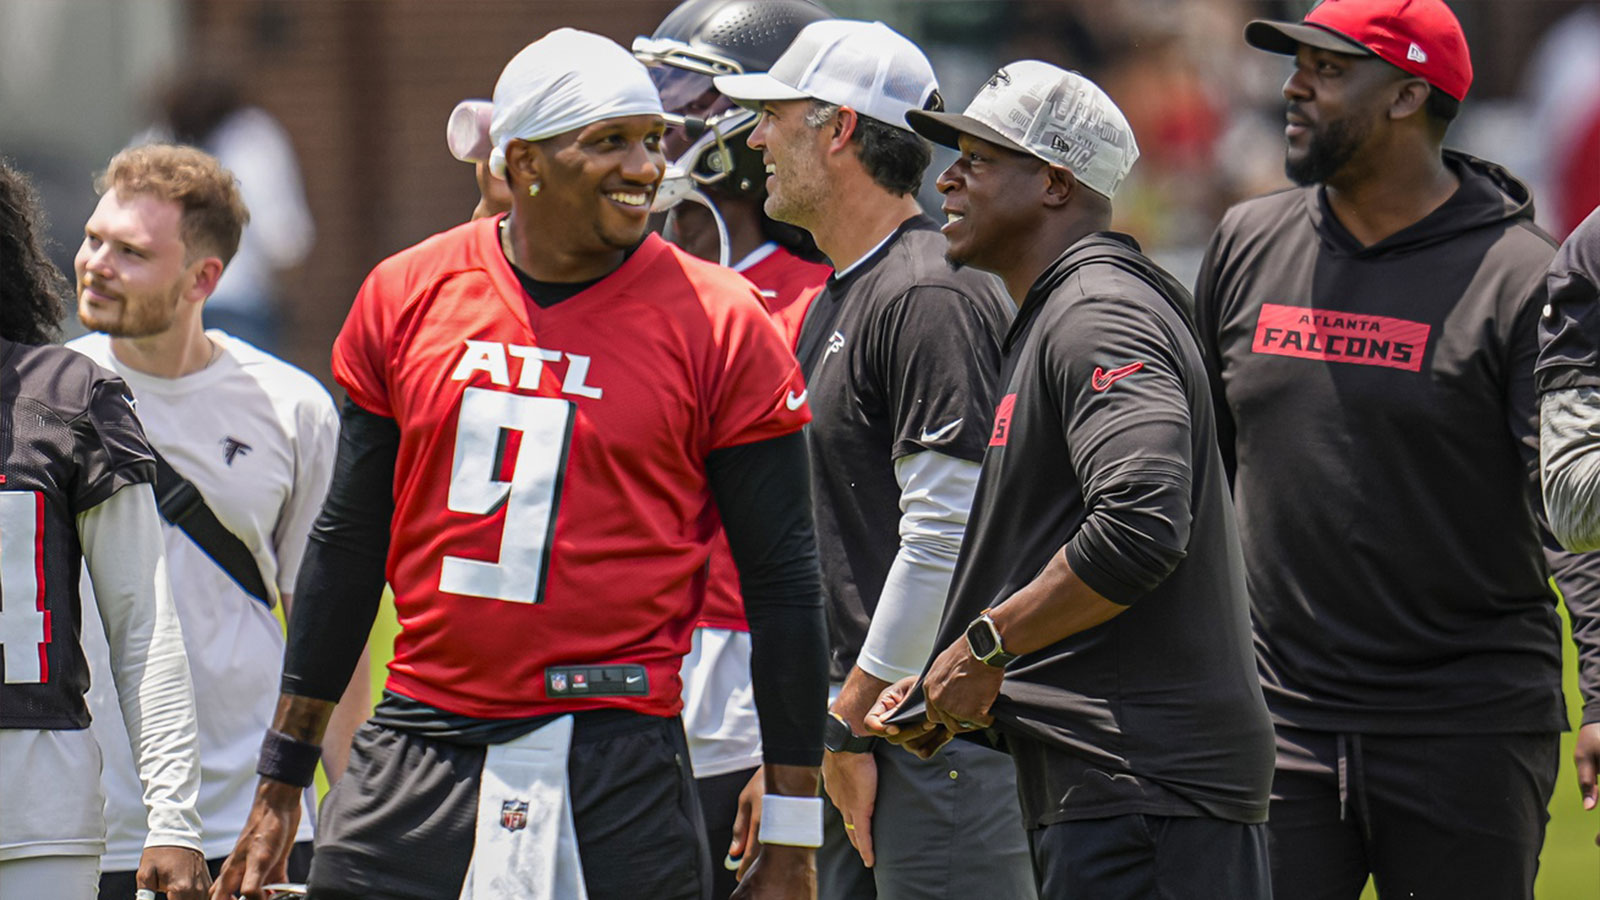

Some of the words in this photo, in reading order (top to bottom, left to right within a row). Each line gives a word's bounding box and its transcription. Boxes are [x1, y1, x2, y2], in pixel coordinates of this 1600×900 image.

[1299, 315, 1380, 332] ATLANTA
[1263, 328, 1414, 363] FALCONS
[451, 339, 603, 399] ATL
[438, 386, 577, 604] 9
[602, 671, 610, 681] L
